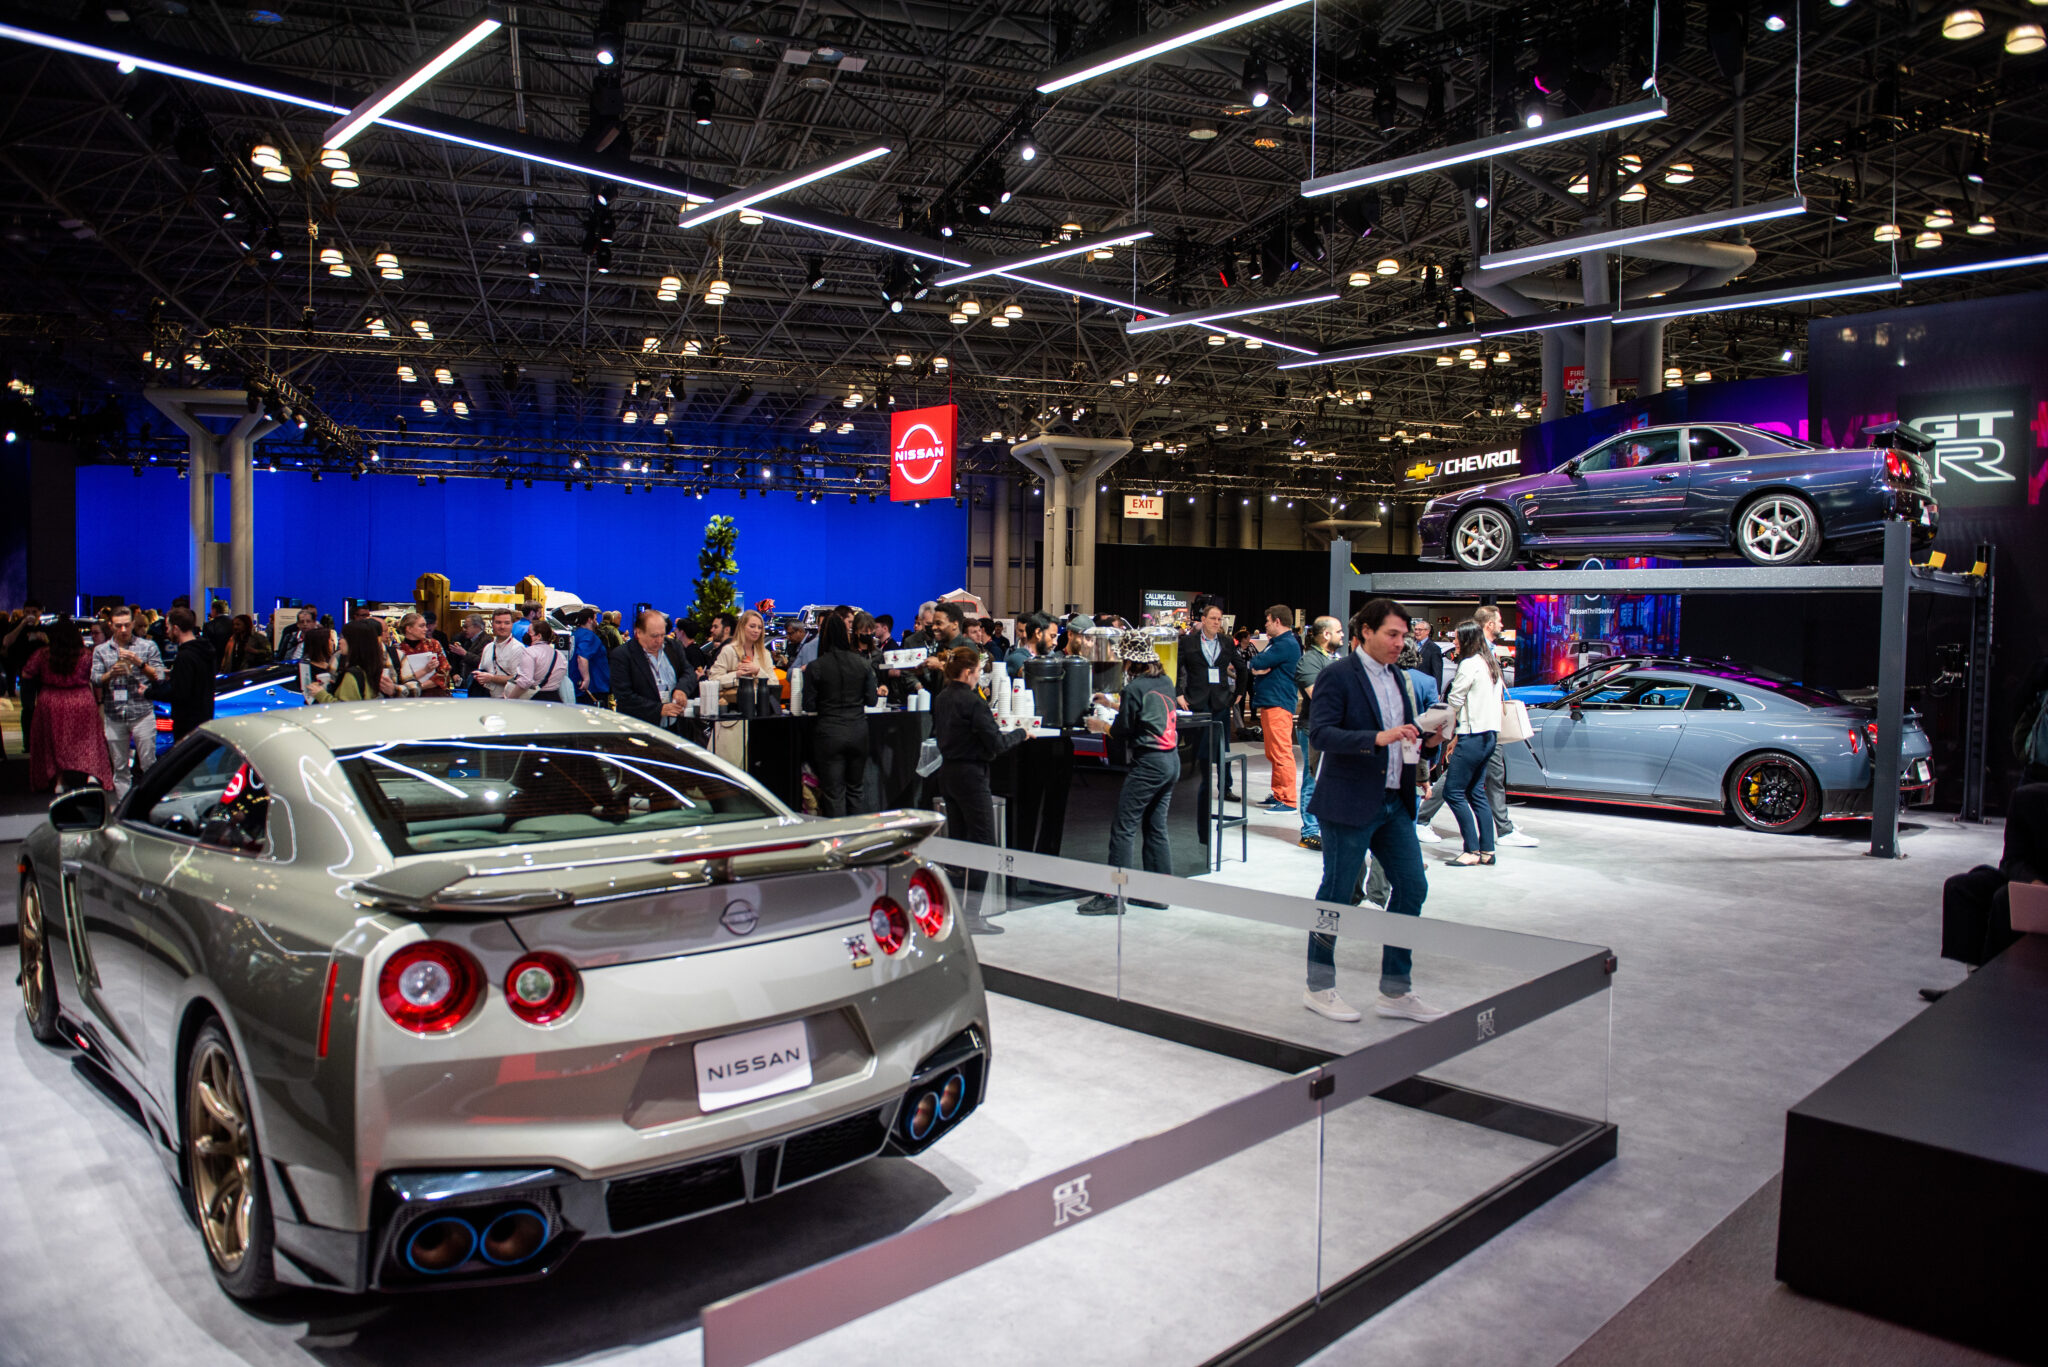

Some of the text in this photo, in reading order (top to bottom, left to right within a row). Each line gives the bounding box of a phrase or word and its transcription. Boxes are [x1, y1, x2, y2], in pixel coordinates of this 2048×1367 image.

[895, 446, 944, 462] NISSAN
[1444, 448, 1521, 475] CHEVROL
[1132, 498, 1154, 509] EXIT
[708, 1047, 800, 1082] NISSAN
